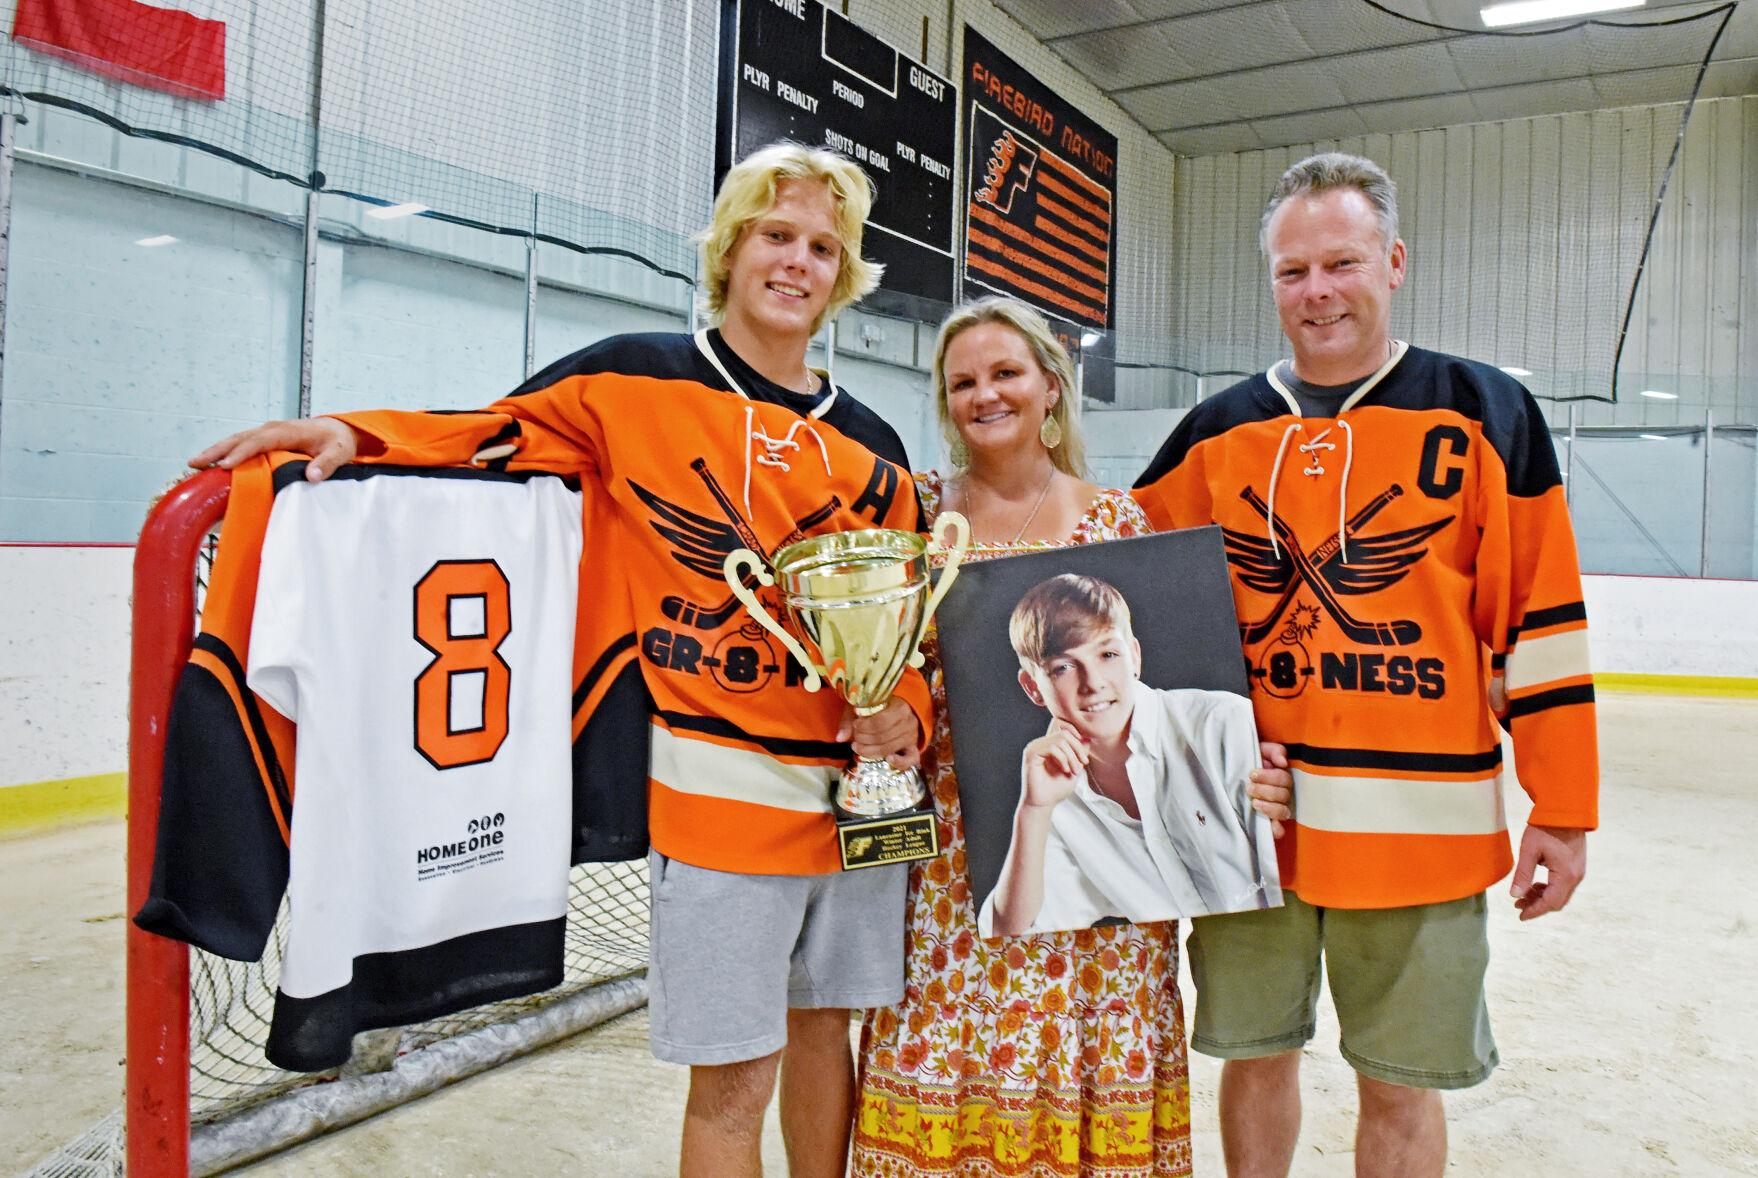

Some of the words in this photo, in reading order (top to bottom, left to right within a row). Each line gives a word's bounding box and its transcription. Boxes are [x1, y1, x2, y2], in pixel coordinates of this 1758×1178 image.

[743, 63, 770, 92] PLYR
[777, 80, 819, 115] PENALTY
[832, 80, 865, 110] PERIOD
[909, 66, 946, 103] GUEST
[972, 61, 1055, 137] FIREBIRD
[824, 128, 855, 157] SHOTS
[855, 143, 868, 161] ON
[869, 150, 891, 173] GOAL
[896, 141, 916, 164] PLYR
[920, 154, 951, 181] PENALTY
[1417, 424, 1470, 501] C
[850, 456, 899, 526] A
[413, 558, 512, 771] 8
[878, 847, 930, 859] CHAMPIONS
